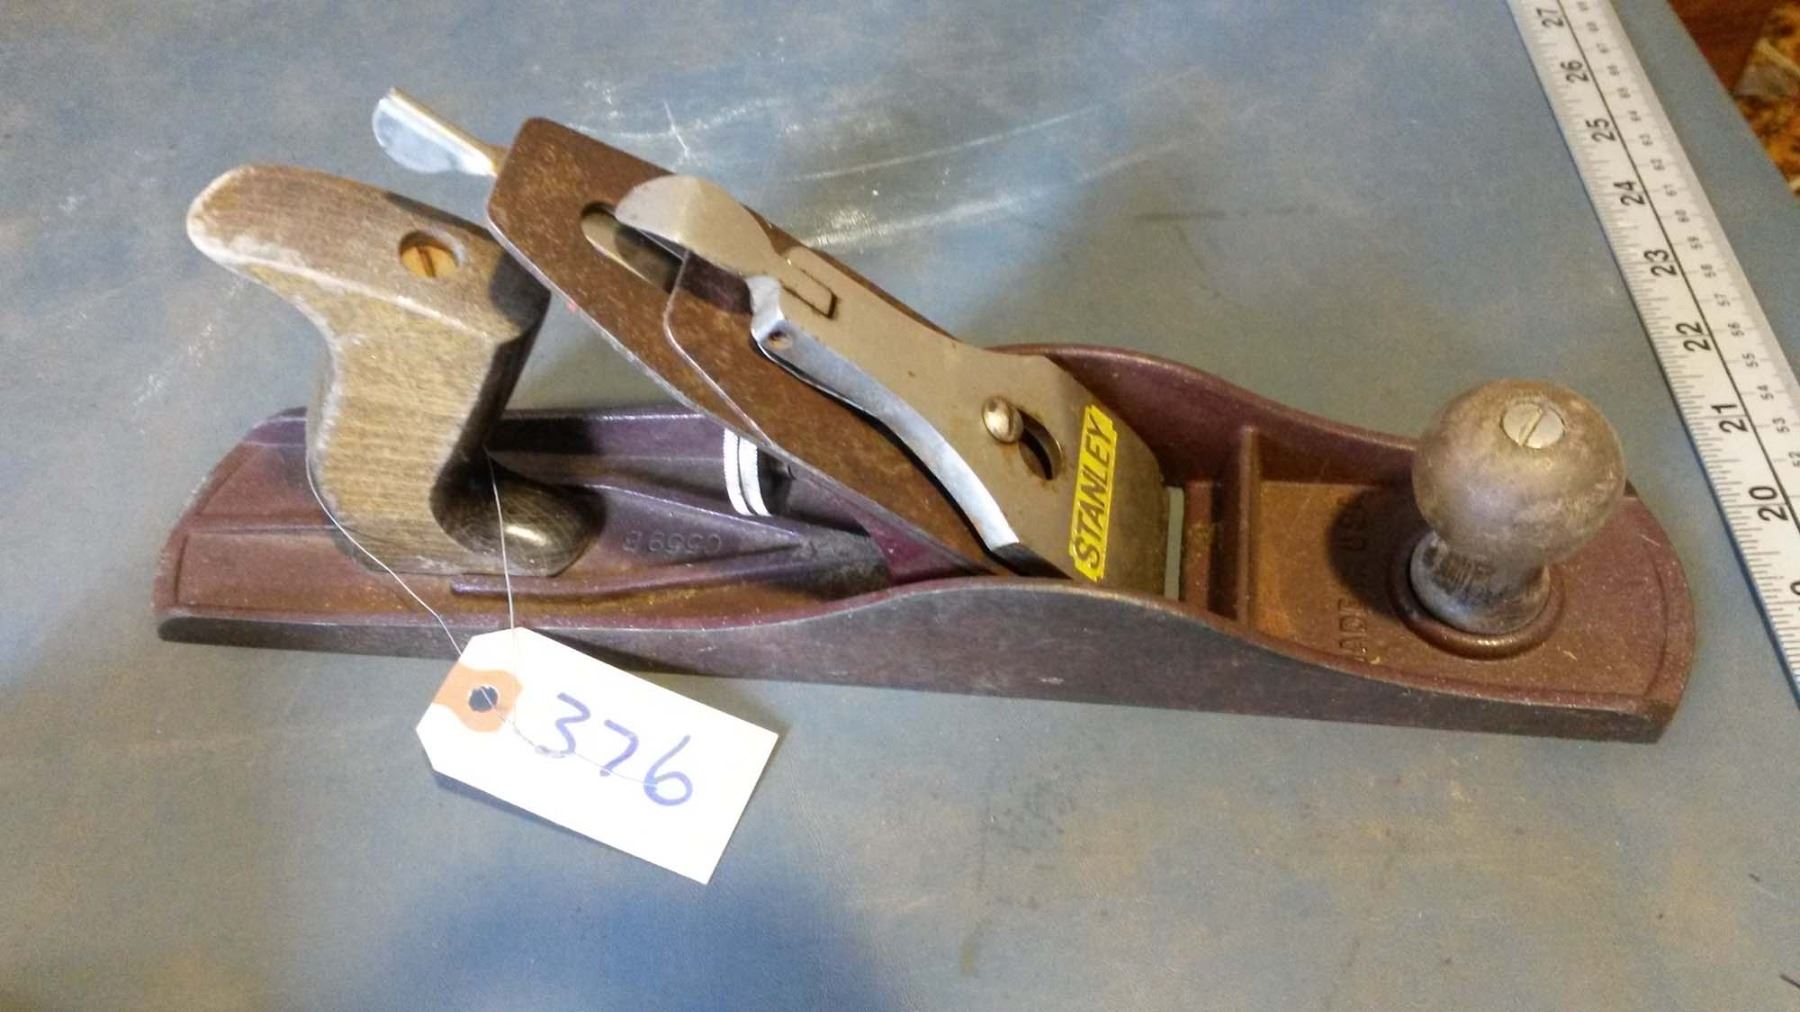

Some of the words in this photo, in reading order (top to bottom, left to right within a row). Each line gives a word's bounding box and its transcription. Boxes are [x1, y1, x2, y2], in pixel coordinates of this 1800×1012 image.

[1536, 7, 1564, 28] 27
[1560, 60, 1589, 83] 26
[1584, 118, 1616, 142] 25
[1613, 181, 1645, 206] 24
[1662, 184, 1677, 197] 61
[1686, 236, 1703, 249] 59
[1643, 249, 1677, 277] 23
[1700, 263, 1717, 277] 58
[1714, 293, 1731, 307] 57
[1675, 322, 1711, 352] 22
[1727, 322, 1745, 337] 56
[1741, 352, 1759, 368] 55
[1757, 385, 1774, 401] 54
[1711, 404, 1748, 433] 21
[1771, 416, 1791, 433] 53
[1075, 411, 1112, 570] STANLEY
[1748, 486, 1788, 521] 20
[532, 691, 694, 807] 376
